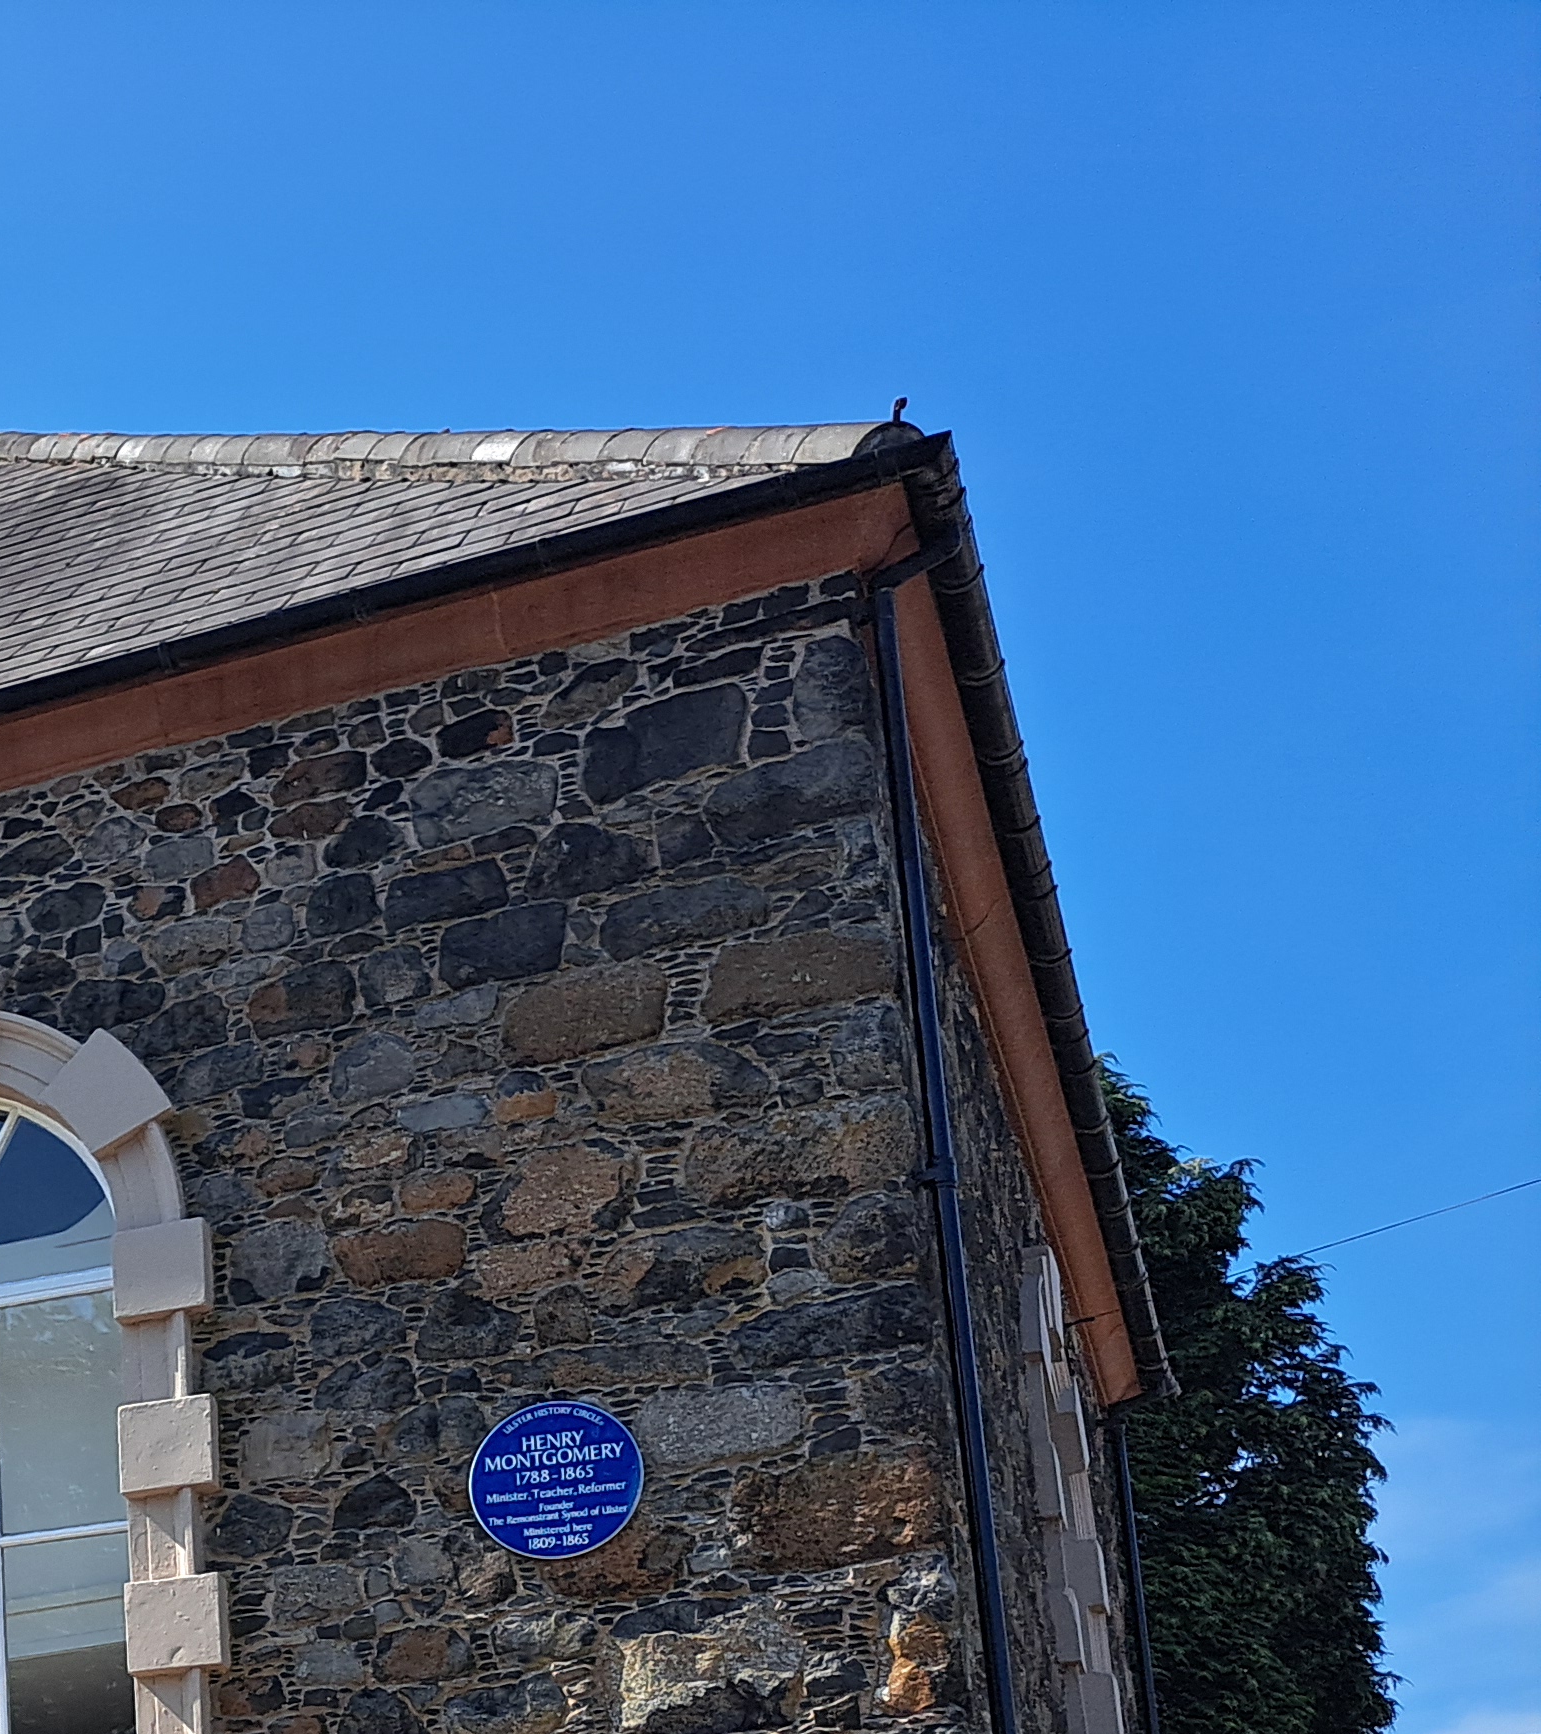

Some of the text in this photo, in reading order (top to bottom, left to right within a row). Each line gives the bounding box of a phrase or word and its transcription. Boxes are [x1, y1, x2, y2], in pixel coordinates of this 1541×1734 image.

[503, 1412, 534, 1434] ULSTER
[534, 1407, 572, 1419] HISTORY
[522, 1429, 584, 1452] HENRY
[484, 1441, 625, 1473] MONTGOMERY
[578, 1481, 626, 1495] Reformer
[487, 1503, 628, 1526] The Remonstrant Synod of Ulster
[539, 1500, 574, 1512] Founder
[523, 1522, 593, 1537] Ministered here
